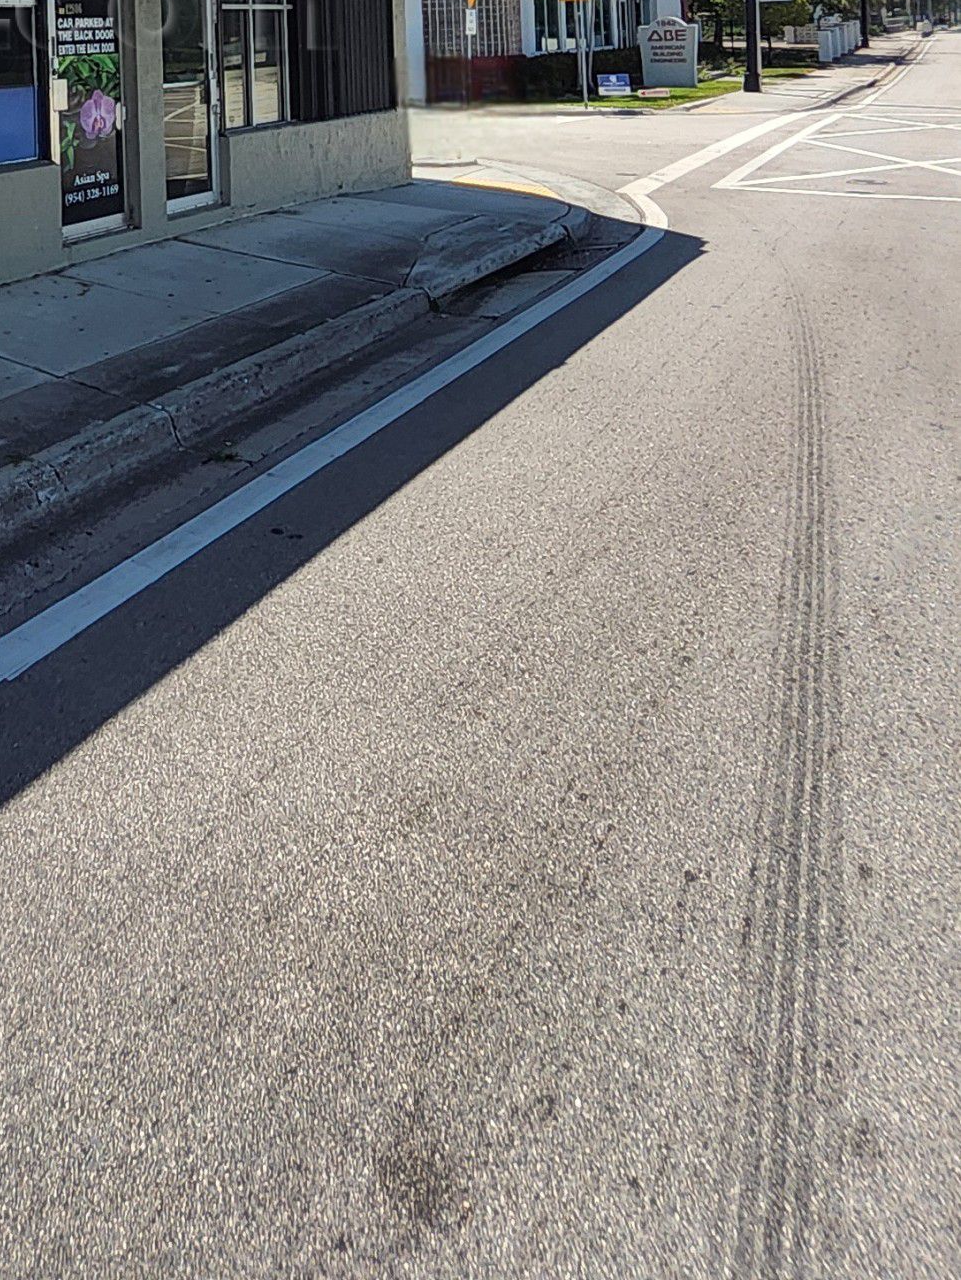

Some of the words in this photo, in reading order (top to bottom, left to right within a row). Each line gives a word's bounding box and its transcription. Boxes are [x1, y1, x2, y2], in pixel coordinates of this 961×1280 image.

[57, 17, 73, 29] CAR
[74, 17, 104, 29] PARKED
[105, 17, 114, 27] AT
[58, 30, 72, 42] THE
[74, 30, 94, 40] BACK
[95, 29, 115, 40] DOOR
[58, 43, 75, 56] ENTER
[76, 43, 86, 54] THE
[101, 41, 115, 53] DOOR
[73, 172, 96, 187] Asian
[96, 170, 110, 184] Spa
[64, 190, 85, 207] (954)
[86, 183, 119, 200] 328-1169
